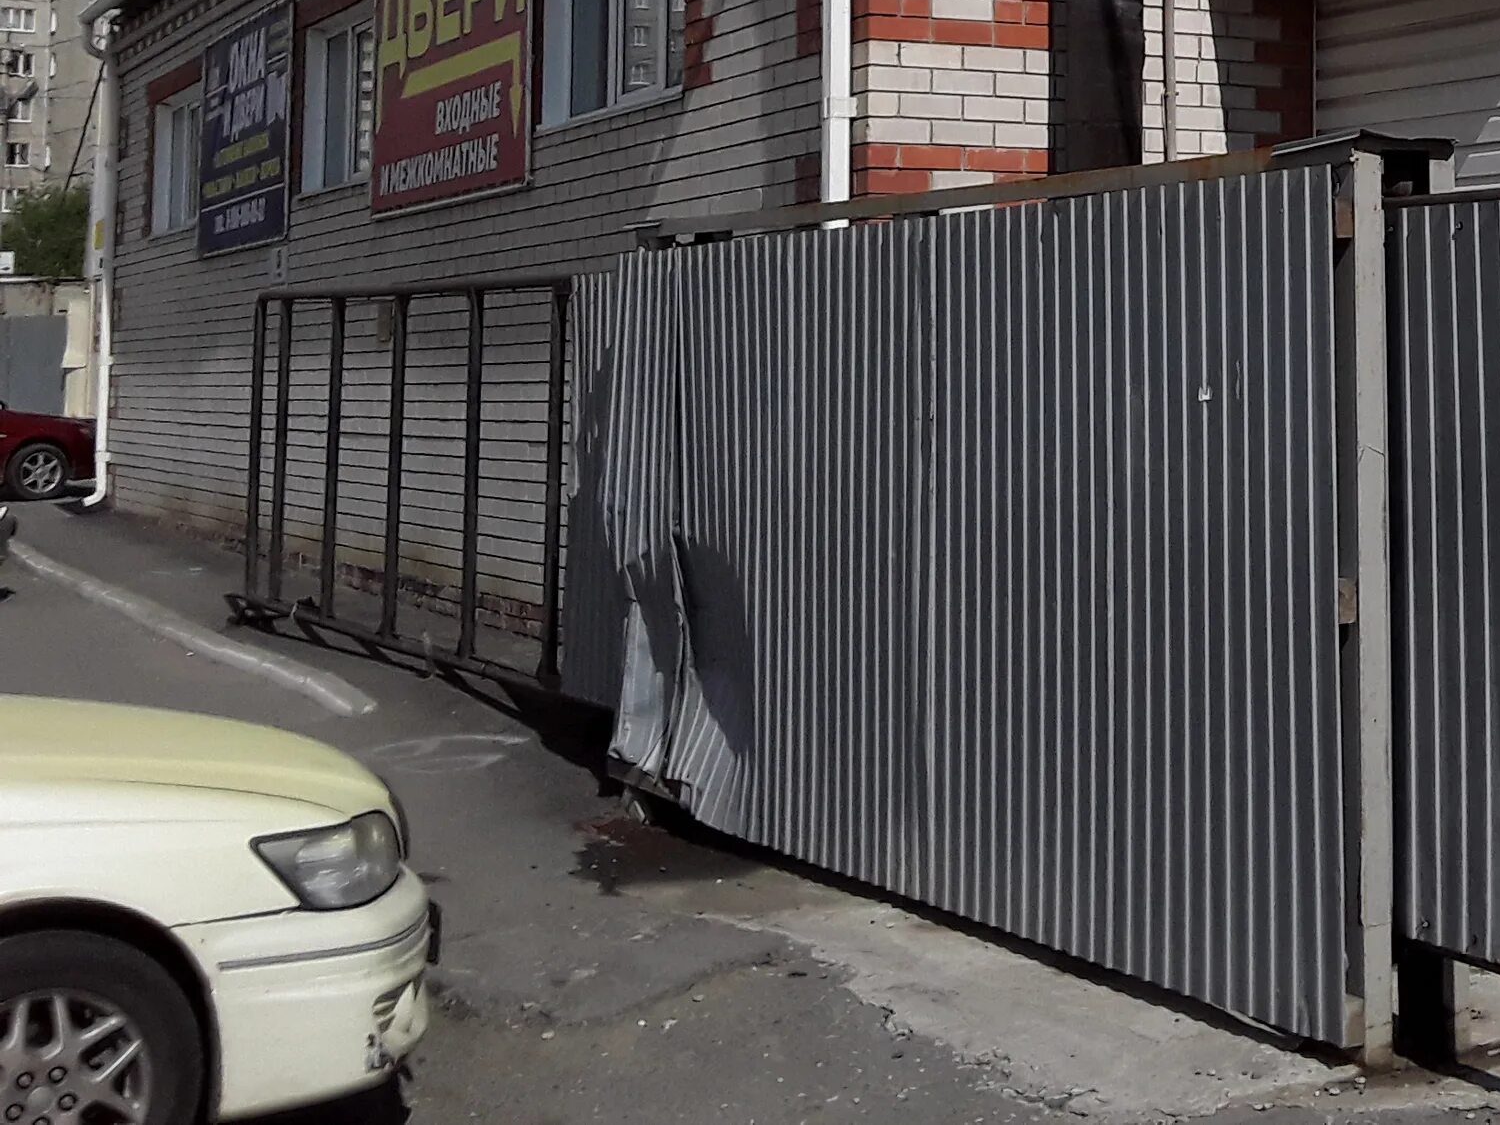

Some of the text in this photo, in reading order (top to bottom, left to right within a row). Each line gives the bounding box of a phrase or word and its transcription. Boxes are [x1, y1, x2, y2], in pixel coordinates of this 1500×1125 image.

[434, 79, 501, 136] ВХОДНЫЕ
[379, 133, 500, 196] И МЕЖКОМНАТНЫЕ
